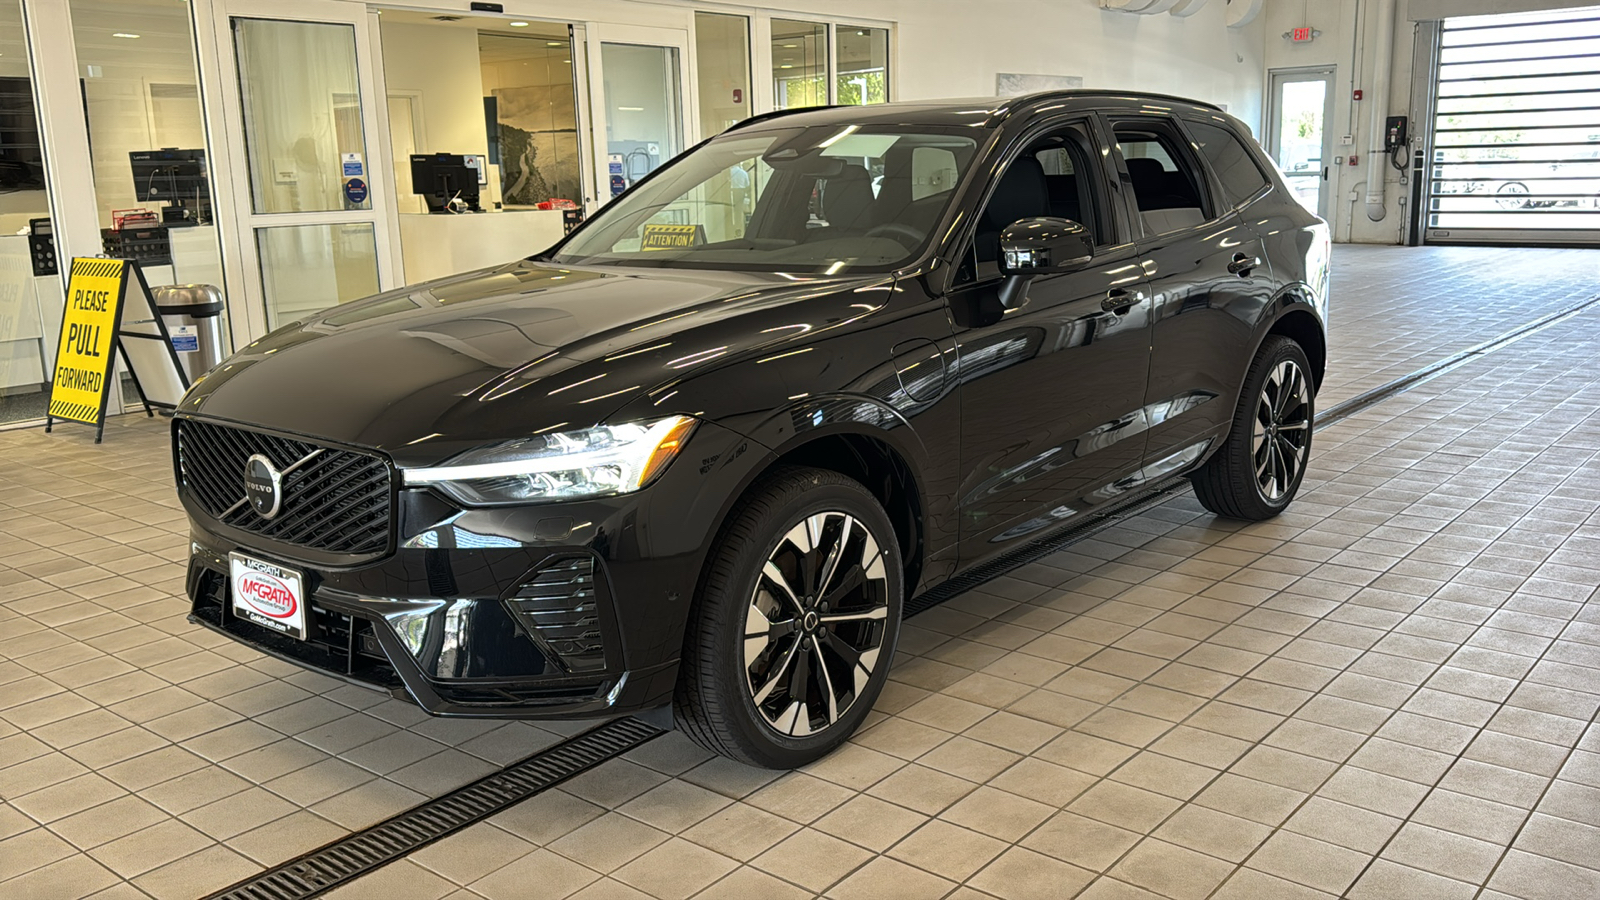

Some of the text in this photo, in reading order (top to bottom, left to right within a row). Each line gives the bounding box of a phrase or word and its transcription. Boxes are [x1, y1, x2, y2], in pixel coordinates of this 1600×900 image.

[1294, 28, 1309, 40] EXIT
[648, 234, 688, 246] ATTENTION
[73, 289, 109, 312] PLEASE
[66, 323, 100, 357] PULL
[56, 366, 102, 393] FORWARD
[246, 481, 272, 493] VOLVO
[243, 578, 290, 607] McGRATH
[250, 613, 286, 631] GoMcGrath.com
